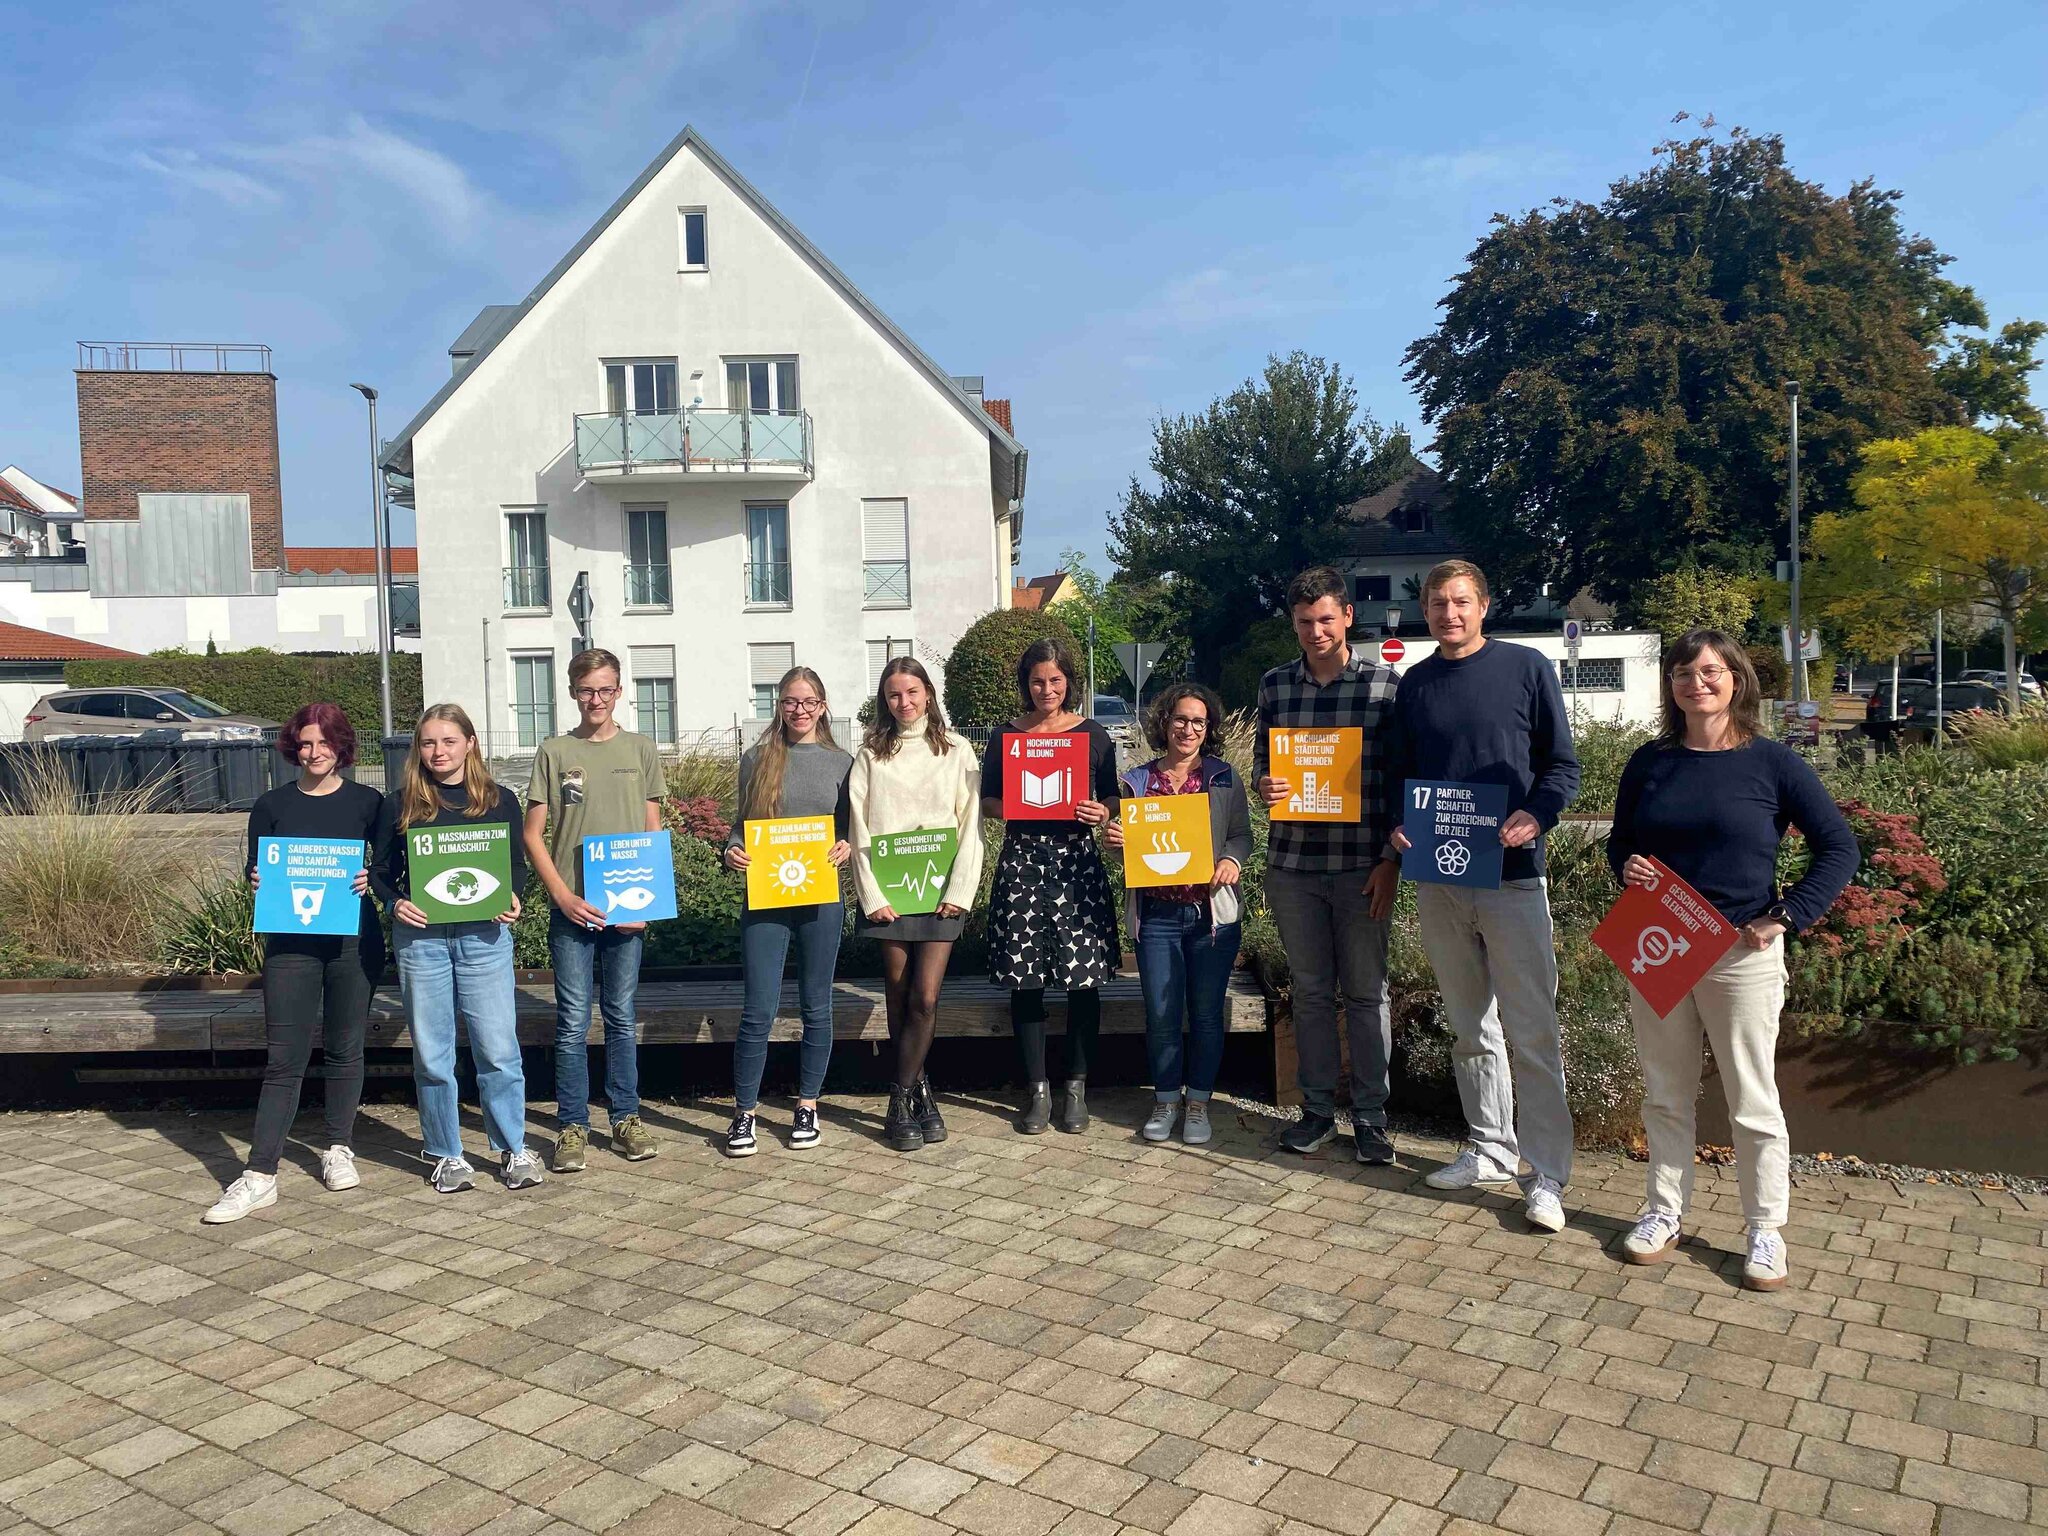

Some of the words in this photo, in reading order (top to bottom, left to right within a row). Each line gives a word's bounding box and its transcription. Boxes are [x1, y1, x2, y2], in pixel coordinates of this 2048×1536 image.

[1026, 738, 1072, 748] HOCHWERTIGE
[1275, 734, 1289, 755] 11
[1294, 734, 1341, 744] NACHHALTIGE
[1010, 739, 1021, 758] 4
[1026, 749, 1054, 758] BILDUNG
[1294, 744, 1320, 755] STÄDTE
[1320, 745, 1335, 755] UND
[1294, 756, 1333, 766] GEMEINDEN
[1412, 786, 1432, 809] 17
[1436, 787, 1474, 800] PARTNER-
[1144, 802, 1160, 812] KEIN
[1436, 800, 1476, 813] SCHAFTEN
[1127, 804, 1138, 824] 2
[1145, 812, 1172, 823] HUNGER
[1435, 812, 1451, 824] ZUR
[1451, 813, 1498, 827] ERREICHUNG
[811, 821, 826, 831] UND
[1435, 824, 1450, 836] DER
[1450, 826, 1470, 837] ZIELE
[437, 830, 490, 843] MASSNAHMEN
[490, 828, 507, 840] ZUM
[752, 825, 762, 846] 7
[893, 834, 933, 846] GESUNDHEIT
[933, 833, 947, 842] UND
[287, 843, 329, 855] SAUBERES
[329, 845, 361, 857] WASSER
[412, 833, 433, 856] 13
[438, 841, 490, 854] KLIMASCHUTZ
[610, 839, 630, 850] LEBEN
[630, 838, 652, 849] UNTER
[877, 839, 888, 857] 3
[894, 843, 941, 855] WOHLERGEHEN
[267, 843, 280, 865] 6
[588, 841, 606, 863] 14
[610, 849, 638, 860] WASSER
[287, 855, 304, 865] UND
[304, 855, 340, 867] SANITÄR-
[286, 866, 347, 879] EINRICHTUNGEN
[1660, 893, 1702, 934] GLEICHHEIT
[1668, 883, 1722, 936] GESCHLECHTER-
